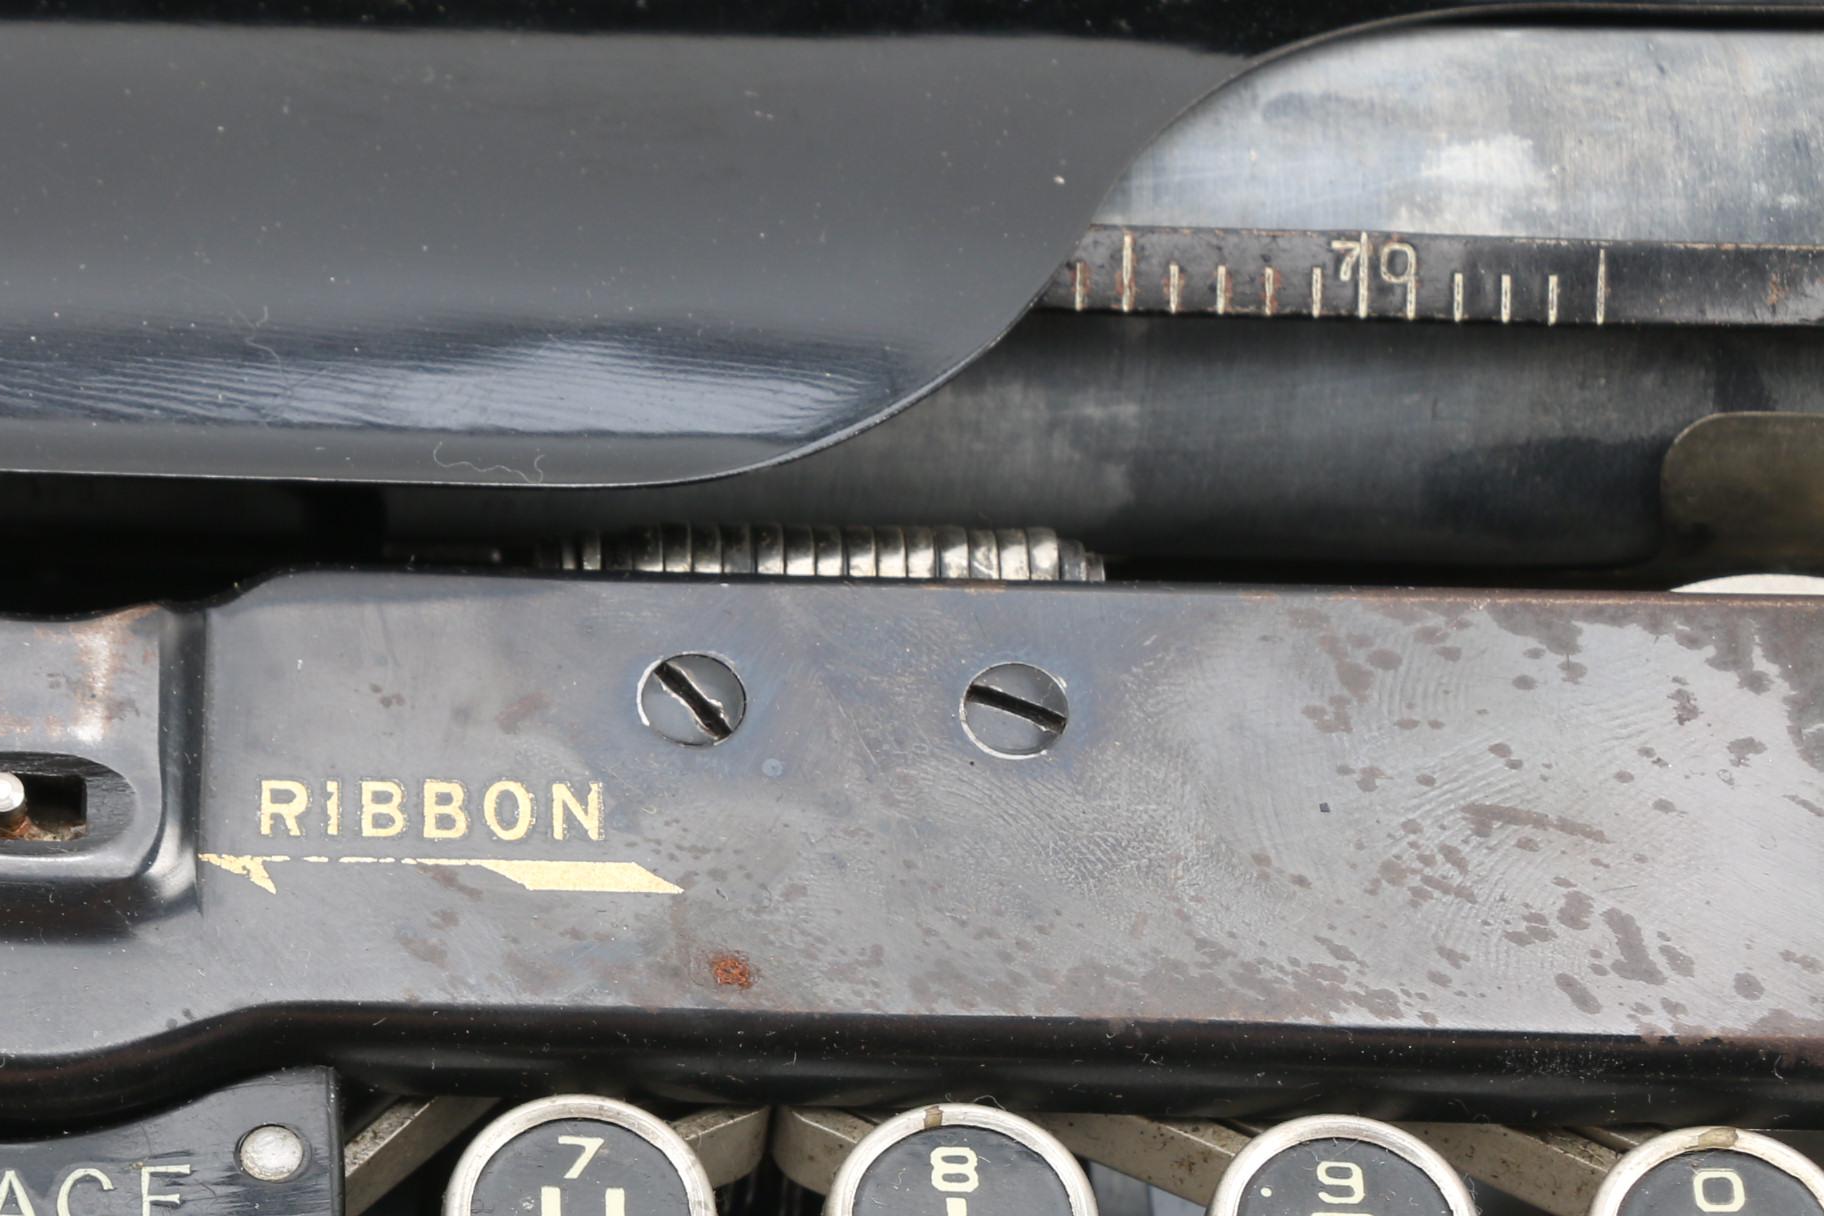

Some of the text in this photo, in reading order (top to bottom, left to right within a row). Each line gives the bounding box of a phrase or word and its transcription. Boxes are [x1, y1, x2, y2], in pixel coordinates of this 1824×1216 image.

[1330, 238, 1417, 285] 70
[257, 779, 605, 842] RIBBON
[558, 1135, 604, 1179] 7
[930, 1147, 979, 1193] 8
[1317, 1161, 1365, 1204] 9
[1692, 1168, 1746, 1212] 0
